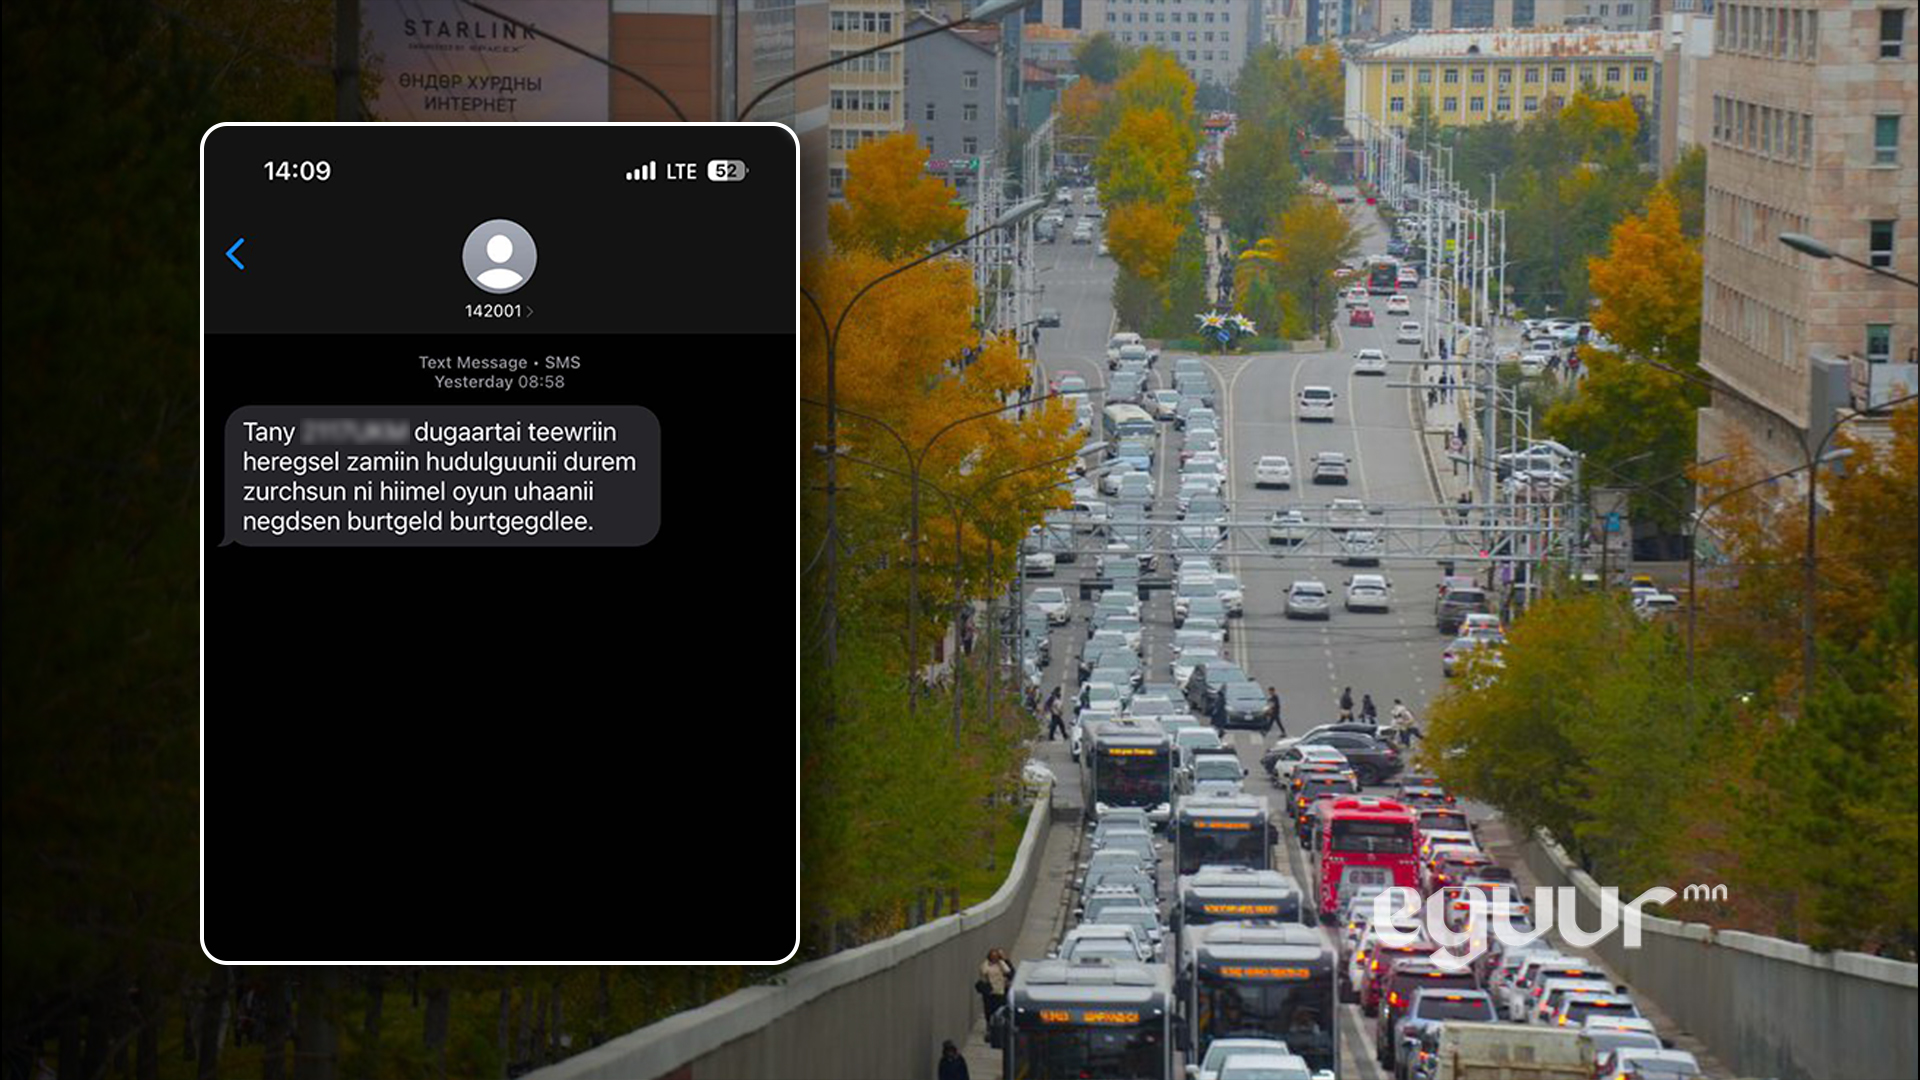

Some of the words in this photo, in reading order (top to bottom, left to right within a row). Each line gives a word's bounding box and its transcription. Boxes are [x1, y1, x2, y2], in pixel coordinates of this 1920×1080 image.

[404, 19, 537, 40] STARLINK
[400, 72, 462, 91] ӨНДӨР
[467, 75, 542, 94] ХУРДНЫ
[424, 96, 518, 113] ИНТЕРНЕТ
